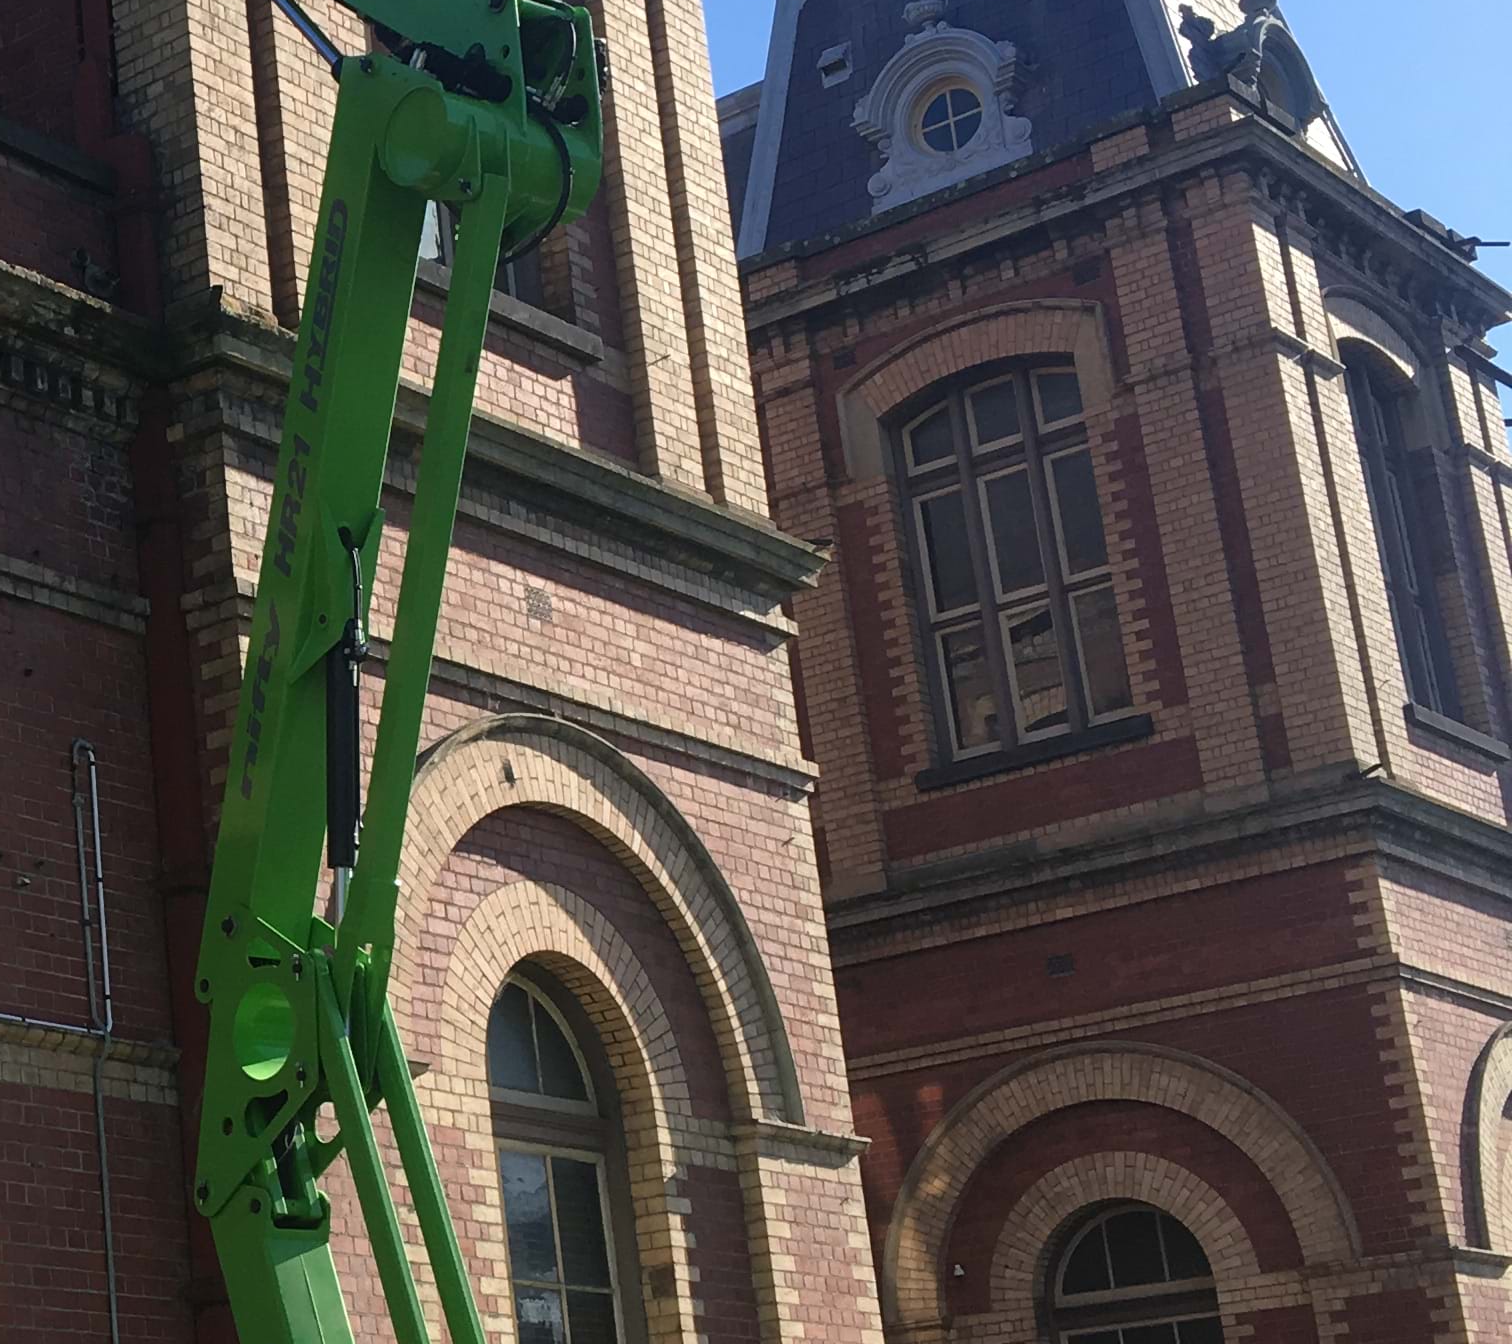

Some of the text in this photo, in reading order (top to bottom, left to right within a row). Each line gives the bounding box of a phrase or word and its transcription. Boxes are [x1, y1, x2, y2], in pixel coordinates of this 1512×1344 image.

[241, 197, 349, 801] nifty HR21 HYBRID
